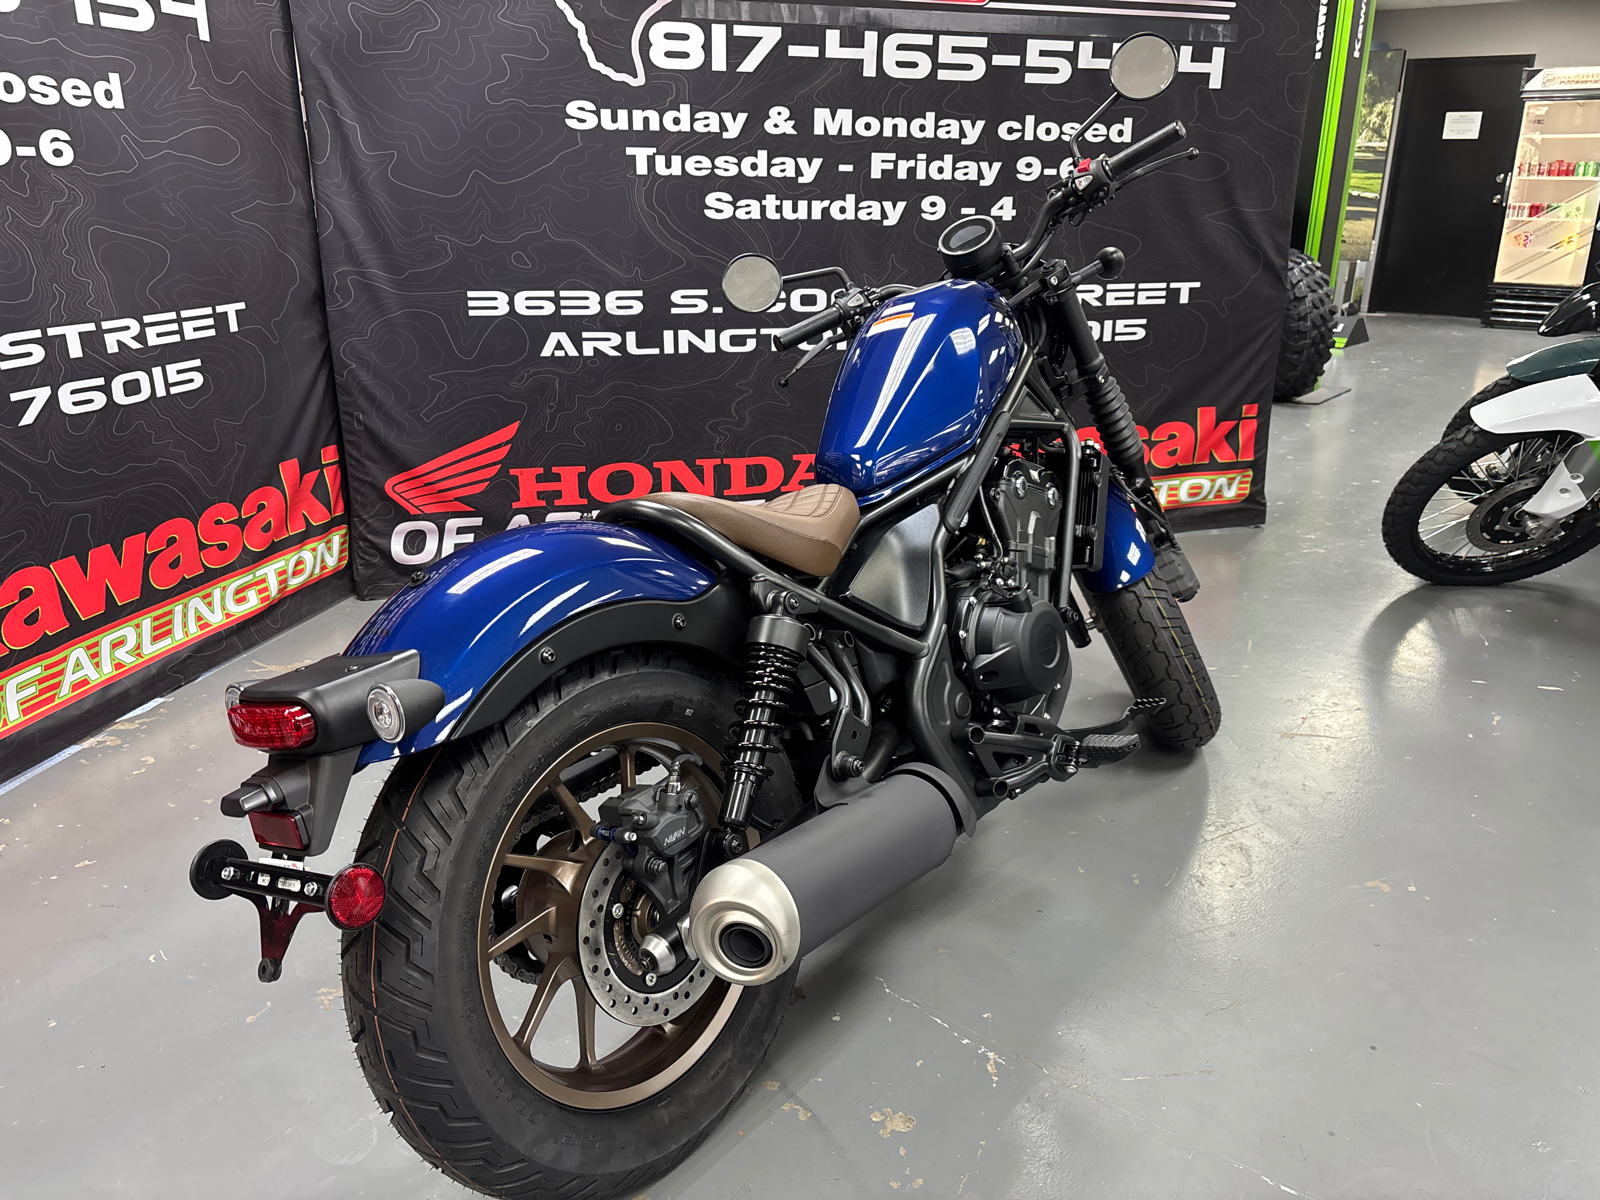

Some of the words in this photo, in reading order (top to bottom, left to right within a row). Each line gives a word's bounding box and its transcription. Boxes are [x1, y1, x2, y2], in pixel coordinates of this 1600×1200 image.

[648, 20, 1226, 90] 817-465-544
[1353, 0, 1367, 58] Kaw
[565, 100, 748, 139] Sunday
[763, 106, 797, 135] &
[813, 108, 985, 145] Monday
[997, 115, 1133, 143] closed
[625, 147, 823, 183] Tuesday
[870, 152, 1002, 186] Friday
[703, 191, 907, 226] Saturday
[920, 195, 946, 220] 9
[990, 196, 1016, 221] 4
[467, 290, 643, 317] 3636
[670, 289, 723, 314] S.
[1075, 281, 1201, 306] REET
[0, 302, 246, 370] STREET
[10, 359, 204, 427] 76015
[0, 444, 345, 656] awasaki
[390, 517, 483, 565] OF
[0, 665, 42, 726] F
[58, 533, 342, 698] ARLINGTON
